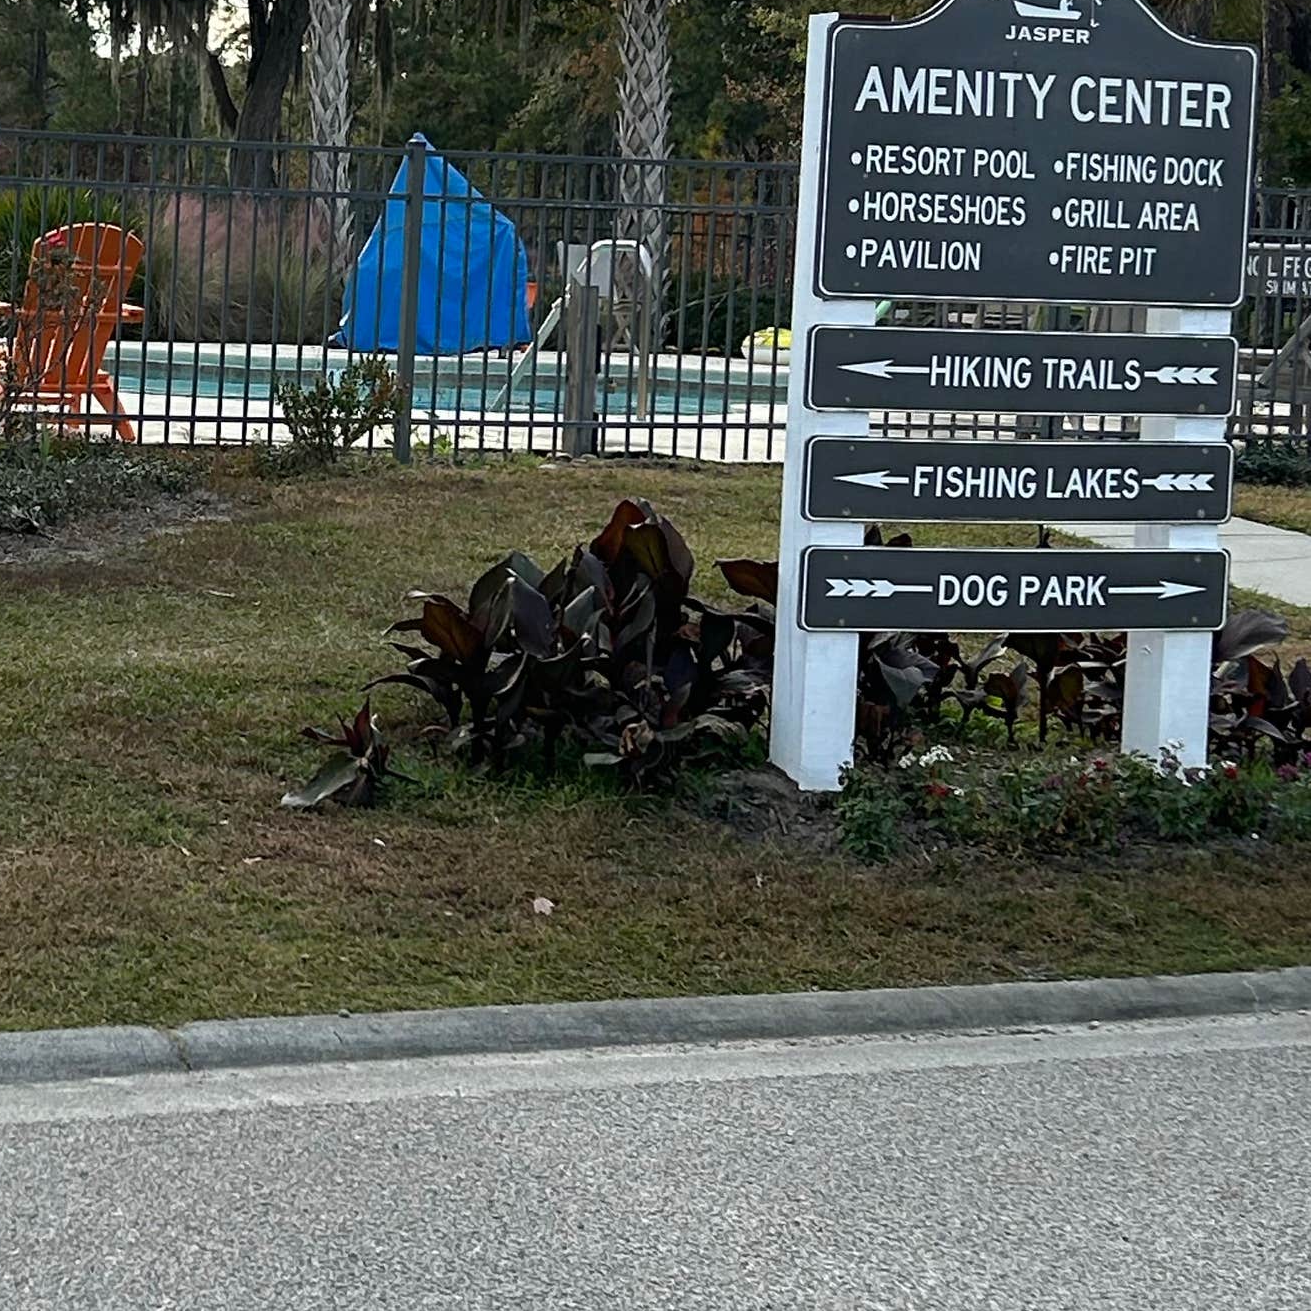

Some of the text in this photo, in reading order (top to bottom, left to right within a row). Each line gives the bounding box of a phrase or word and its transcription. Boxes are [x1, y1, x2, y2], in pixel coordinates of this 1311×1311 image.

[1005, 25, 1091, 45] JASPER
[854, 65, 1232, 129] AMENITY CENTER
[865, 144, 1036, 180] RESORT POOL
[1065, 152, 1224, 187] FISHING DOCK
[863, 190, 1027, 226] HORSESHOES
[1064, 198, 1200, 232] GRILL AREA
[860, 238, 981, 271] PAVILION
[1060, 245, 1157, 277] FIRE PIT
[930, 355, 1141, 391] HIKING TRAILS
[913, 465, 1140, 499] FISHING LAKES
[938, 574, 1107, 607] DOG PARK
